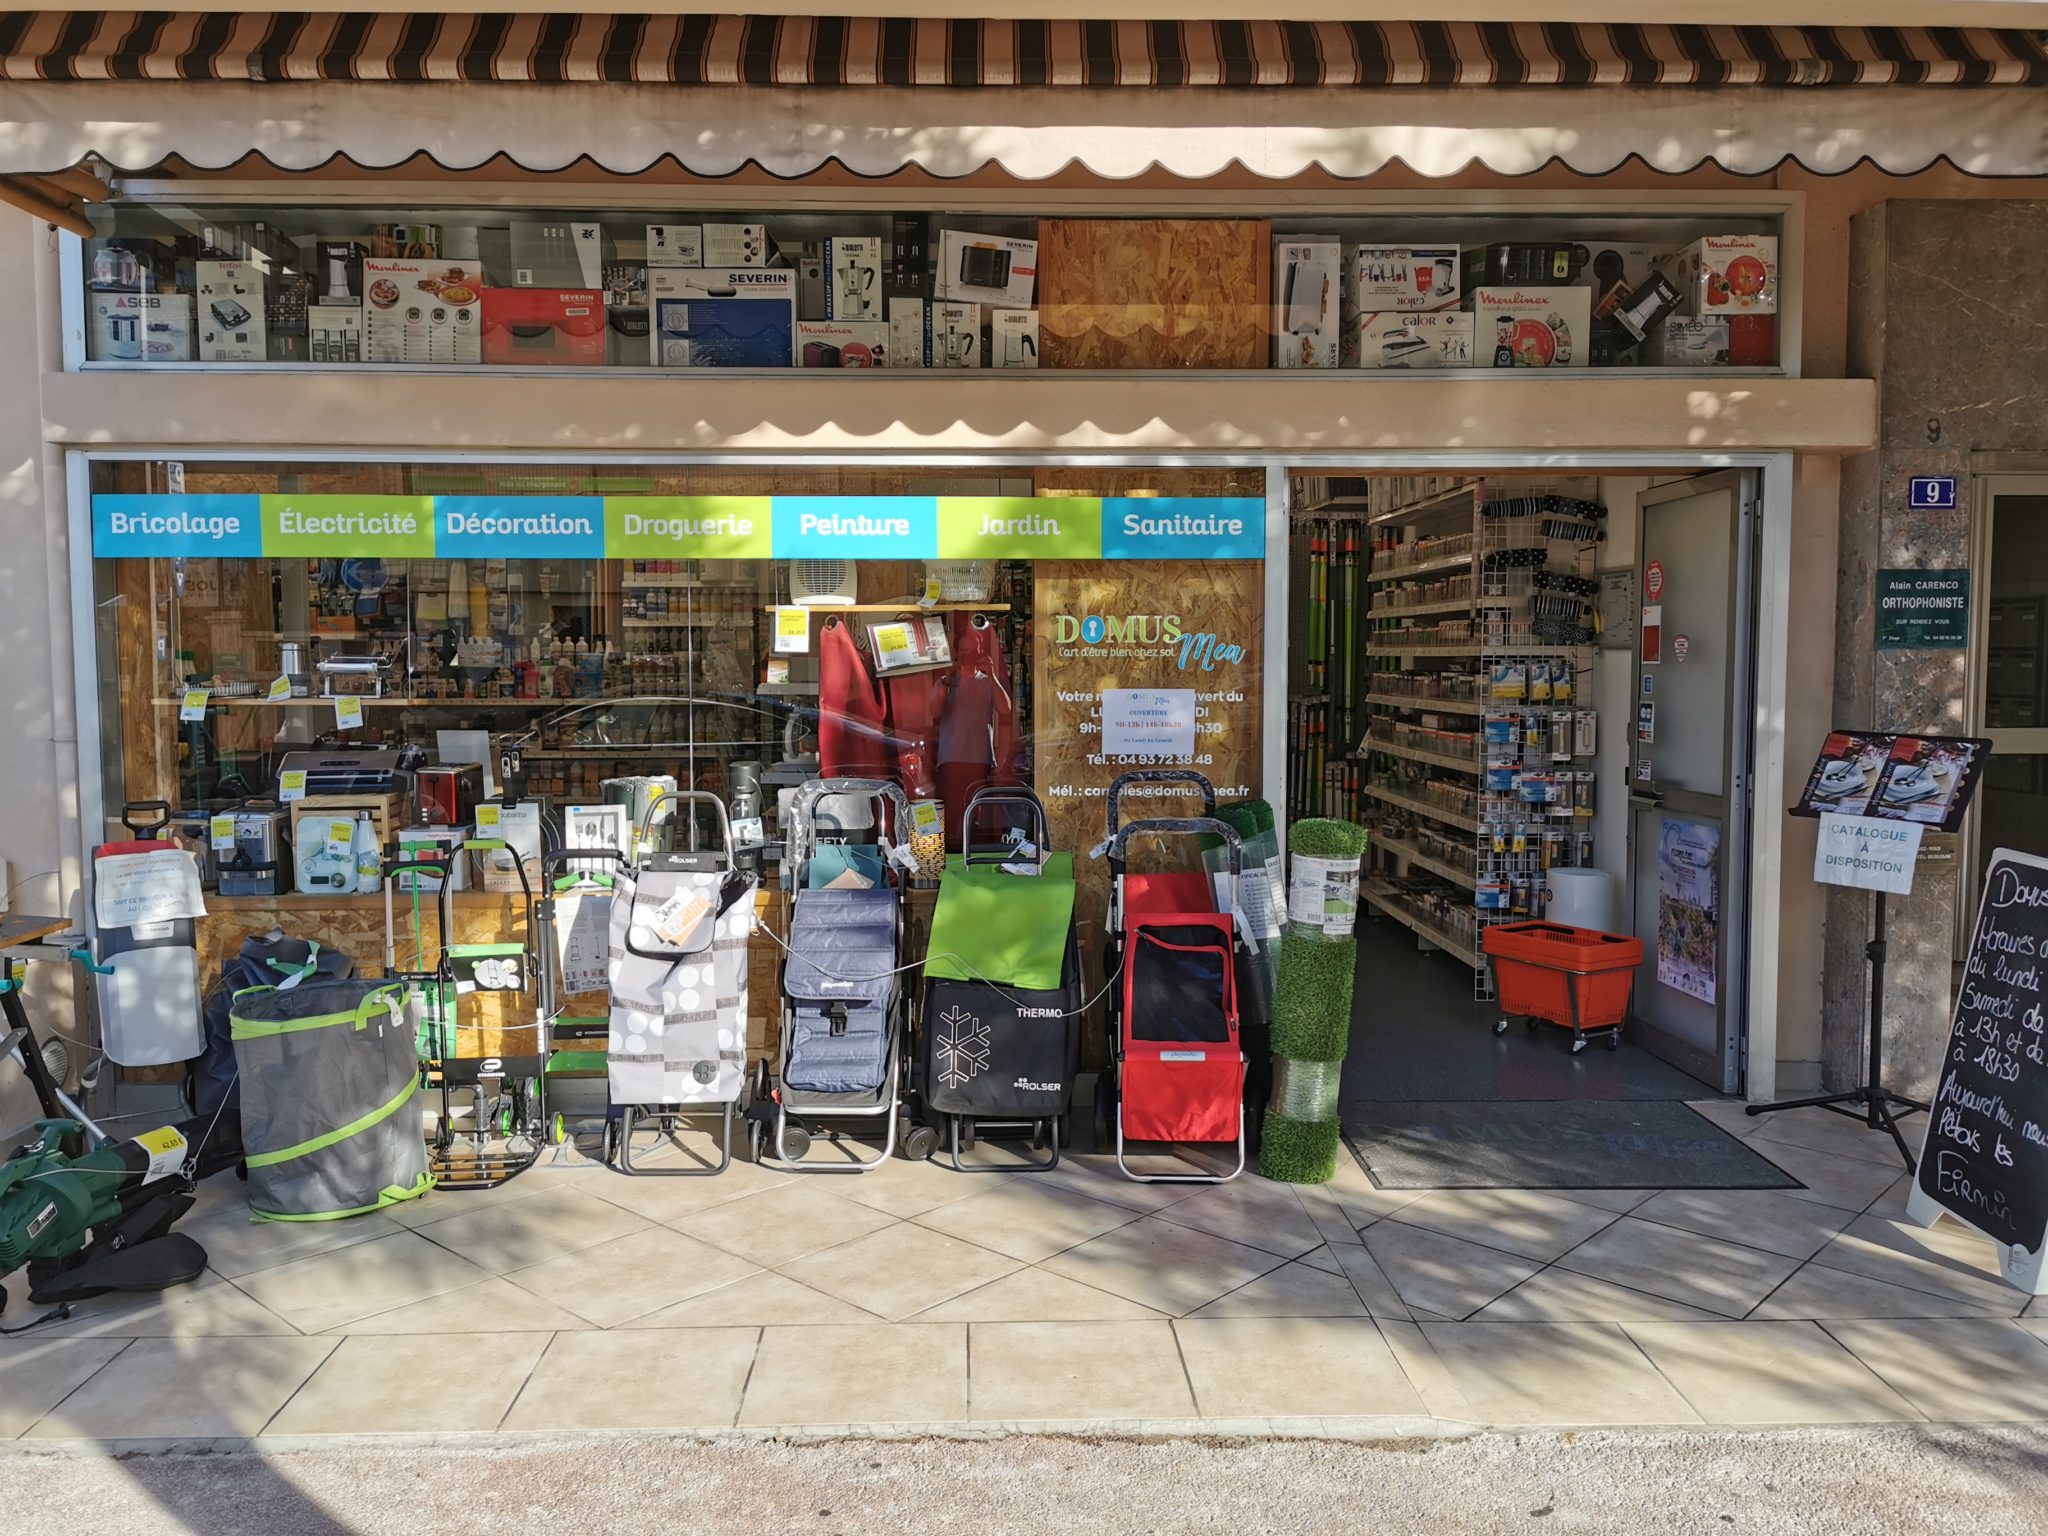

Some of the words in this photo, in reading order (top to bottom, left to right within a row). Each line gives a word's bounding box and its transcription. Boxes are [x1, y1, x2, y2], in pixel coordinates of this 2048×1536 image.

[1705, 238, 1756, 250] Moulinex
[366, 261, 421, 273] Moulinex
[729, 274, 788, 283] SEVERIN
[1478, 290, 1550, 305] Moulinex
[799, 323, 853, 335] Moulinex
[1927, 417, 1941, 443] 9
[1926, 482, 1940, 503] 9
[111, 511, 240, 539] Bricolage
[279, 507, 417, 535] Électricité
[447, 511, 593, 535] Décoration
[623, 513, 753, 540] Droguerie
[799, 512, 910, 535] Peinture
[977, 513, 1061, 536] Jardin
[1123, 513, 1243, 536] Sanitaire
[1889, 581, 1911, 590] Alain
[1915, 581, 1959, 590] CARENCO
[1882, 597, 1964, 609] ORTHOPHONISTE
[1055, 614, 1182, 644] DOMUS
[1059, 646, 1079, 657] l'art
[1110, 646, 1132, 657] bien
[1134, 646, 1158, 657] chez
[1174, 632, 1246, 671] Mea
[1057, 691, 1094, 702] Votre
[1226, 691, 1244, 702] du
[1086, 753, 1110, 765] Tél.
[1118, 753, 1136, 765] 04
[1138, 753, 1155, 765] 93
[1157, 753, 1173, 765] 72
[1175, 753, 1193, 765] 38
[1194, 753, 1213, 765] 48
[1048, 785, 1077, 796] Mél.
[1831, 823, 1909, 842] CATALOGUE
[1825, 855, 1902, 873] DISPOSITION
[1977, 916, 2034, 956] Horaires
[1969, 951, 1987, 979] du
[1993, 955, 2044, 992] lundi
[1016, 1008, 1062, 1018] THERMO
[1961, 982, 2020, 1019] Samedi
[2022, 1002, 2044, 1035] de
[1969, 1015, 2001, 1048] 13h
[2006, 1031, 2022, 1054] et
[2026, 1036, 2044, 1065] de
[1973, 1045, 2020, 1082] 18h30
[1022, 1082, 1061, 1092] ROLSER
[1939, 1069, 2014, 1130] Aujourd'hui
[1994, 1132, 2014, 1167] les
